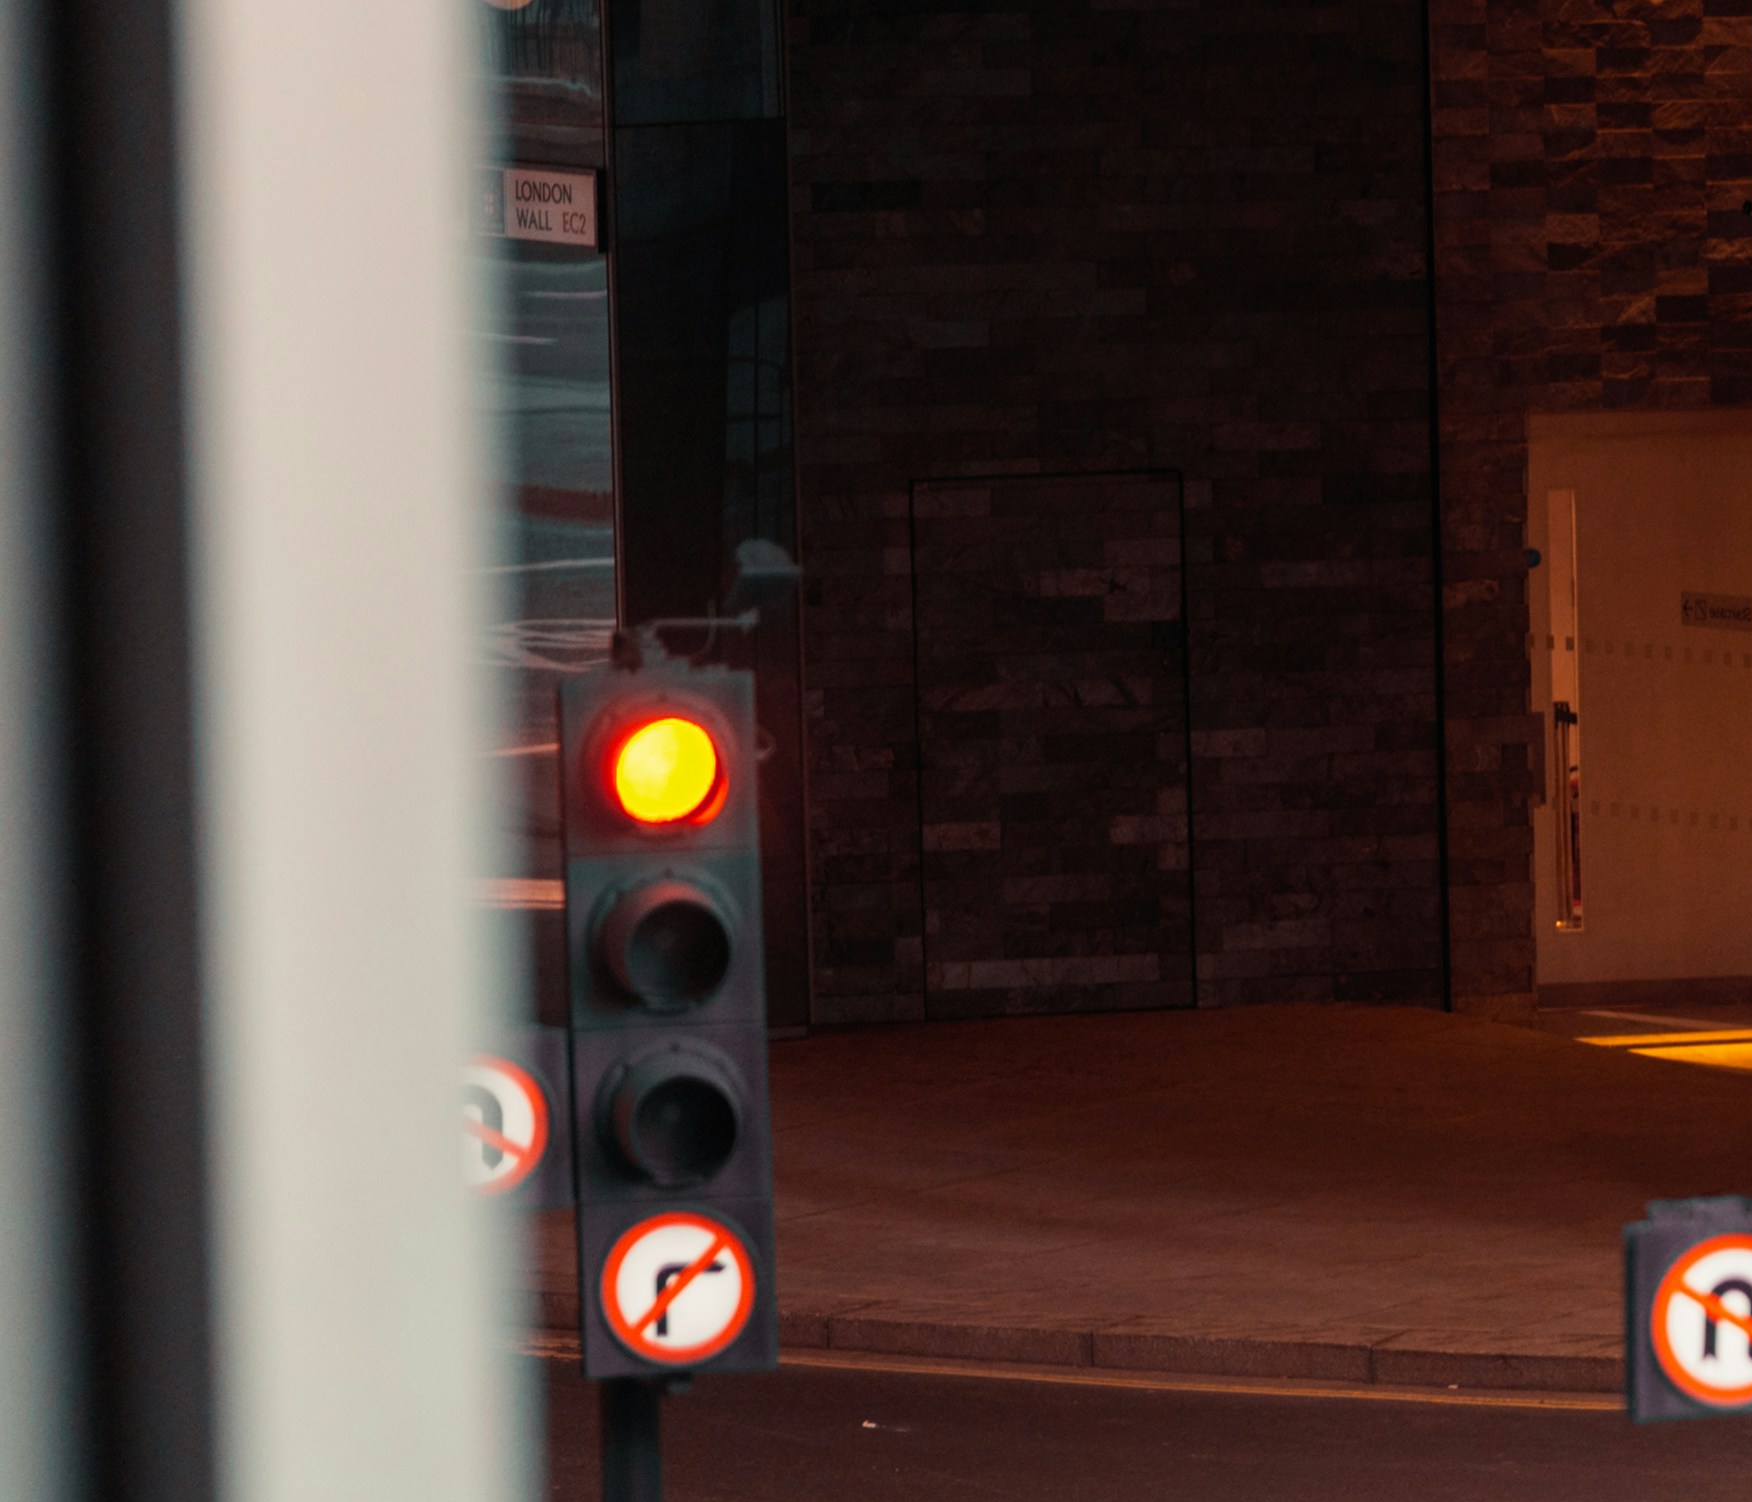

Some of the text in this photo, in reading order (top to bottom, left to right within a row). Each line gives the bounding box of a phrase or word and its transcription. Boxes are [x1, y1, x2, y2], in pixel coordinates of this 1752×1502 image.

[515, 179, 572, 205] LONDON
[516, 208, 587, 235] WALL EC2
